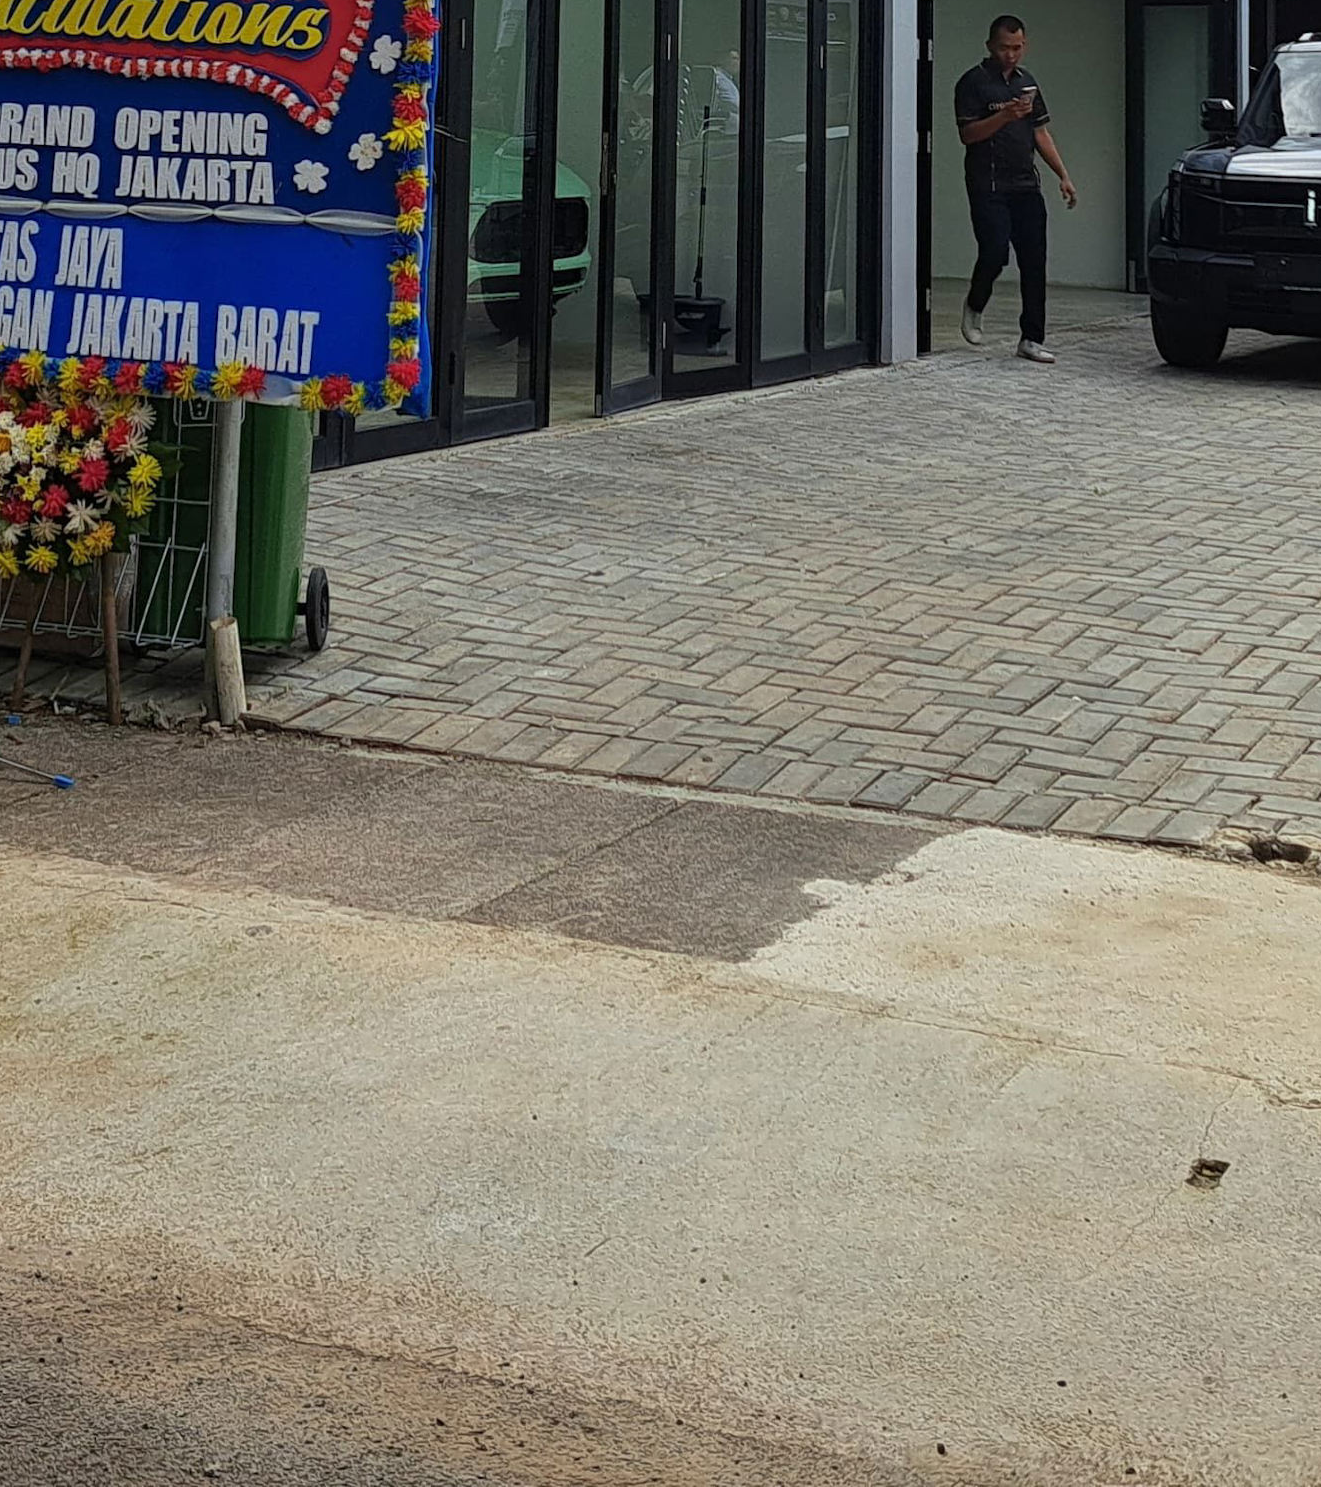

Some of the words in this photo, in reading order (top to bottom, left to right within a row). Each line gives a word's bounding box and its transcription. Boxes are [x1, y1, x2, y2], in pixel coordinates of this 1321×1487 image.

[114, 106, 269, 156] OPENING
[52, 151, 101, 199] HQ
[115, 155, 276, 206] JAKARTA
[55, 224, 124, 290] JAYA
[66, 293, 200, 365] JAKARTA
[215, 304, 320, 375] BARAT
